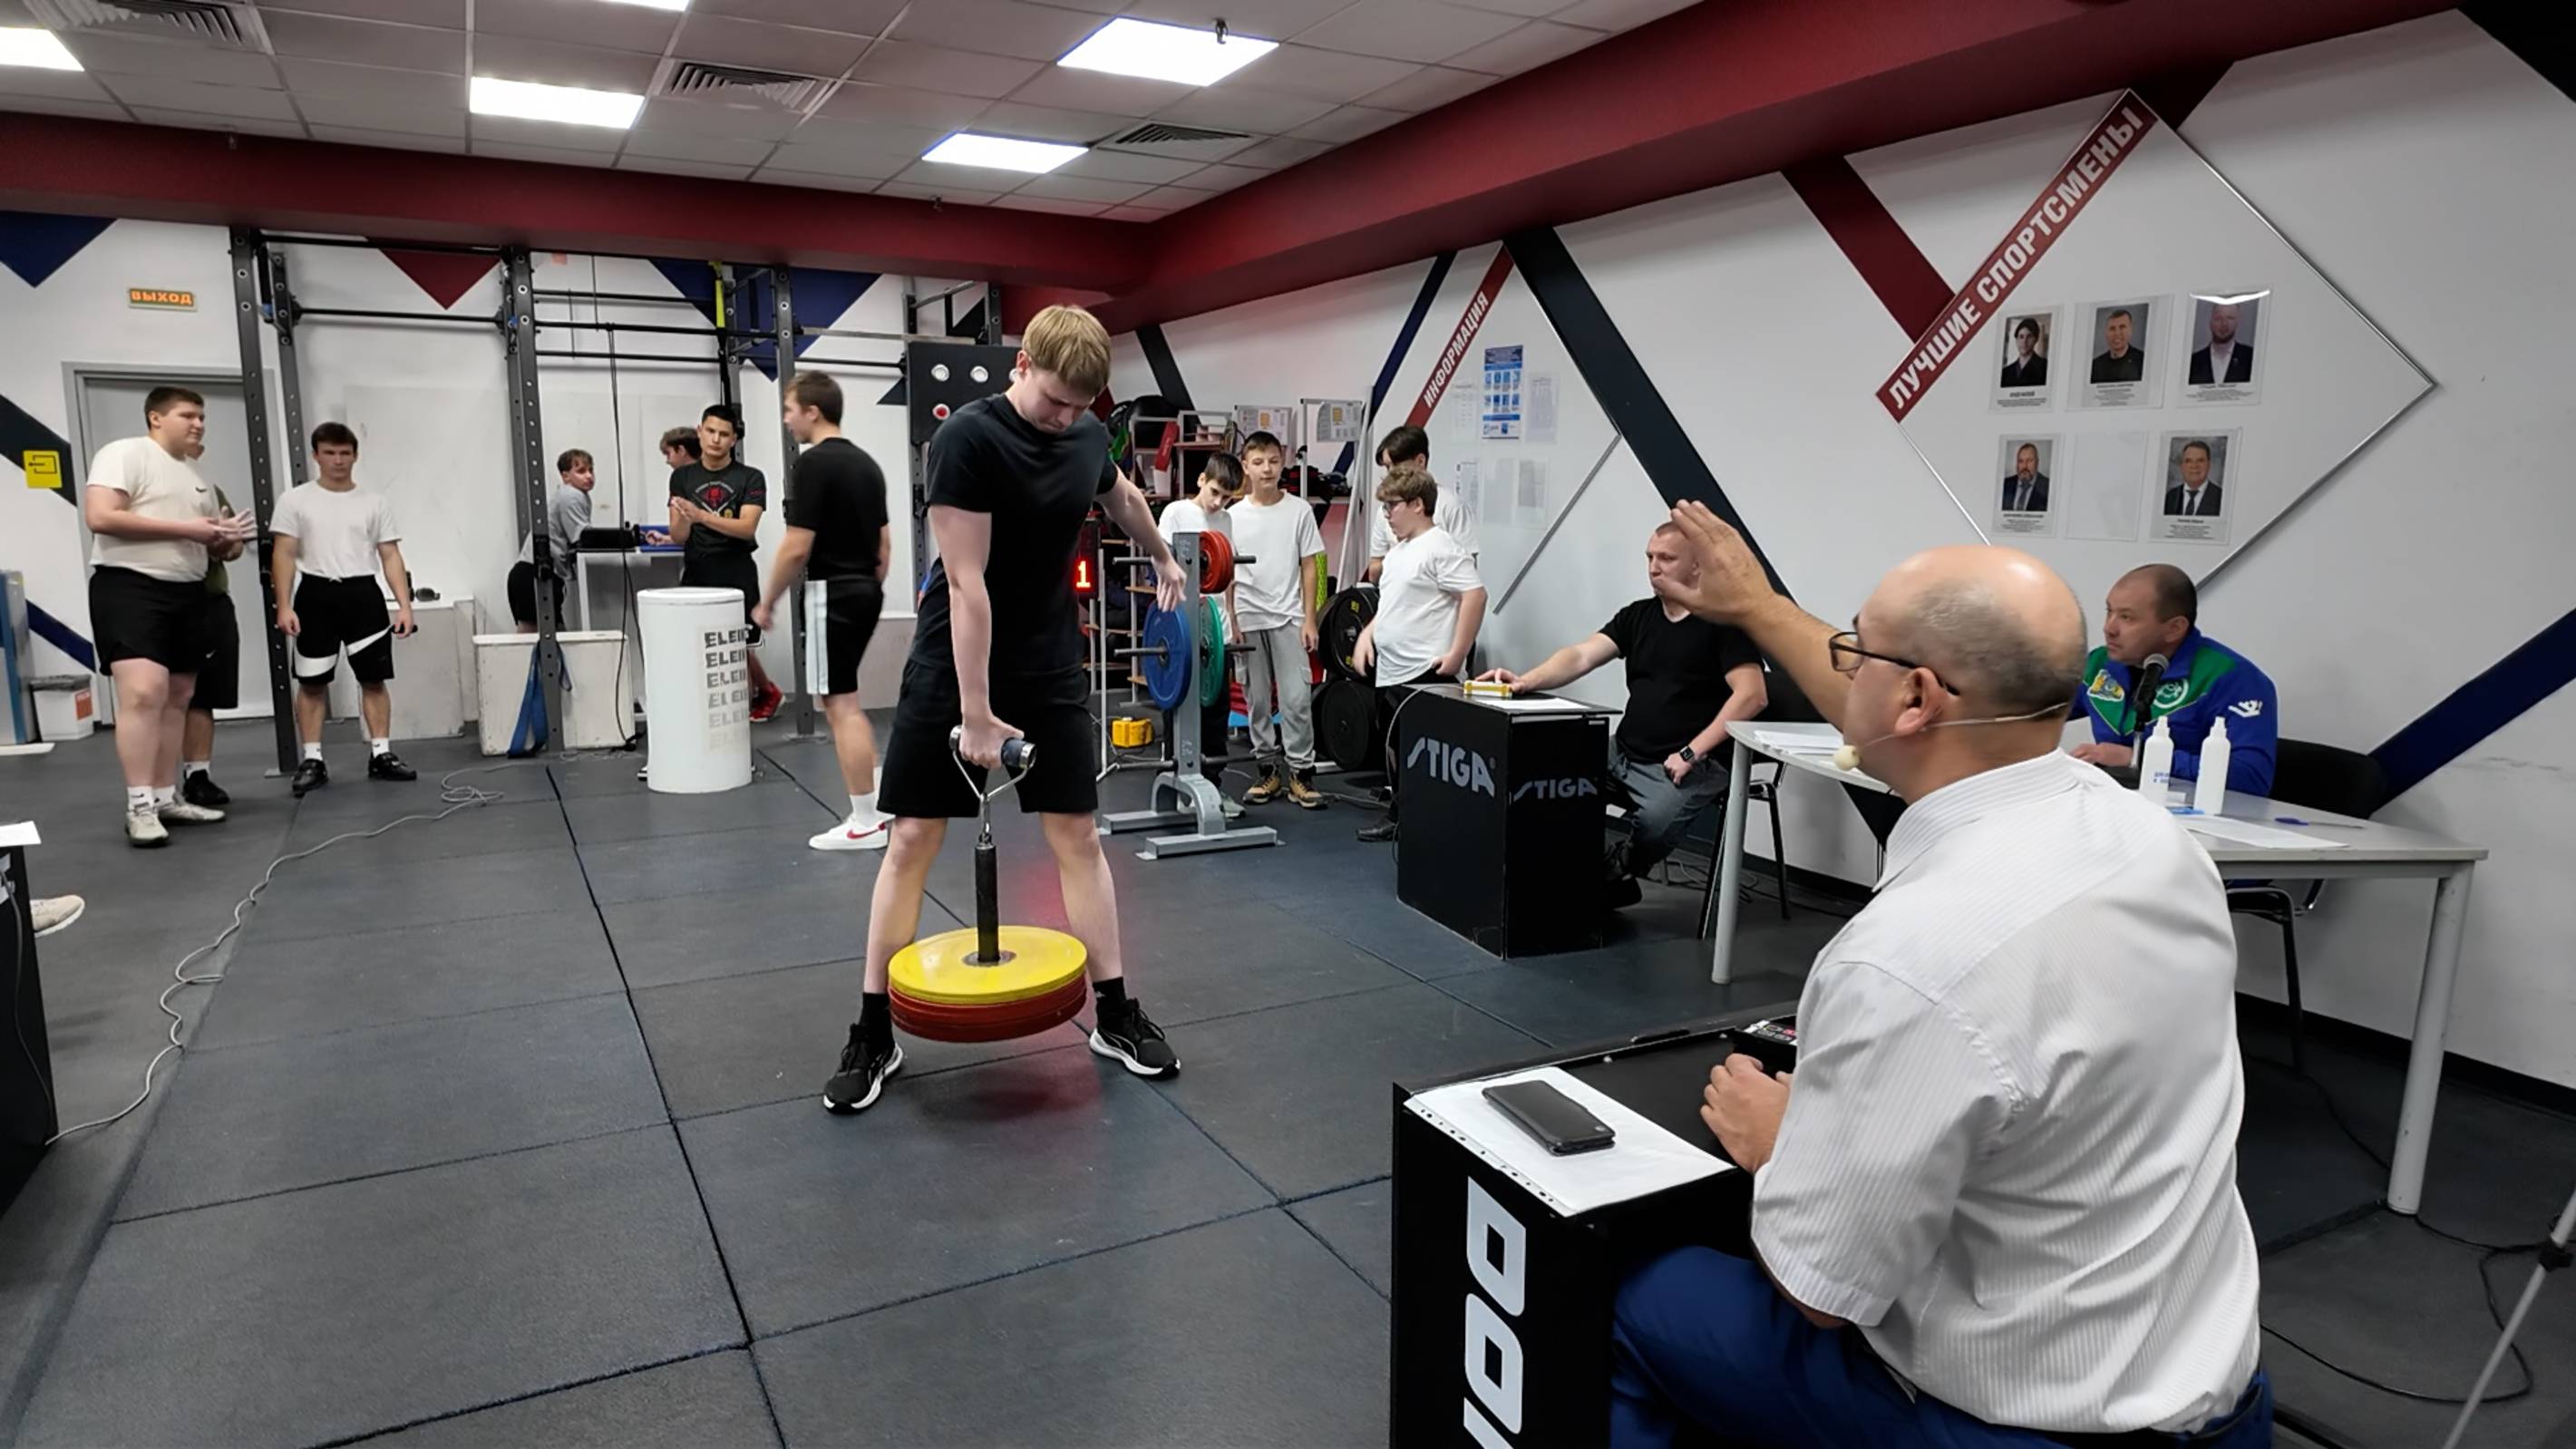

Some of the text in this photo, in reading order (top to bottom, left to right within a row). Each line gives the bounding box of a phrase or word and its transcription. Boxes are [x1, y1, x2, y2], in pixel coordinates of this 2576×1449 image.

[131, 289, 193, 306] ВЫХОД
[1889, 106, 2144, 410] ЛУЧШИЕ СПОРТСМЕНЫ
[1424, 291, 1489, 408] ИНФОРМАЦИЯ
[1407, 736, 1494, 797] STIGA
[1513, 778, 1598, 802] STIGA
[1463, 1175, 1526, 1449] DO
